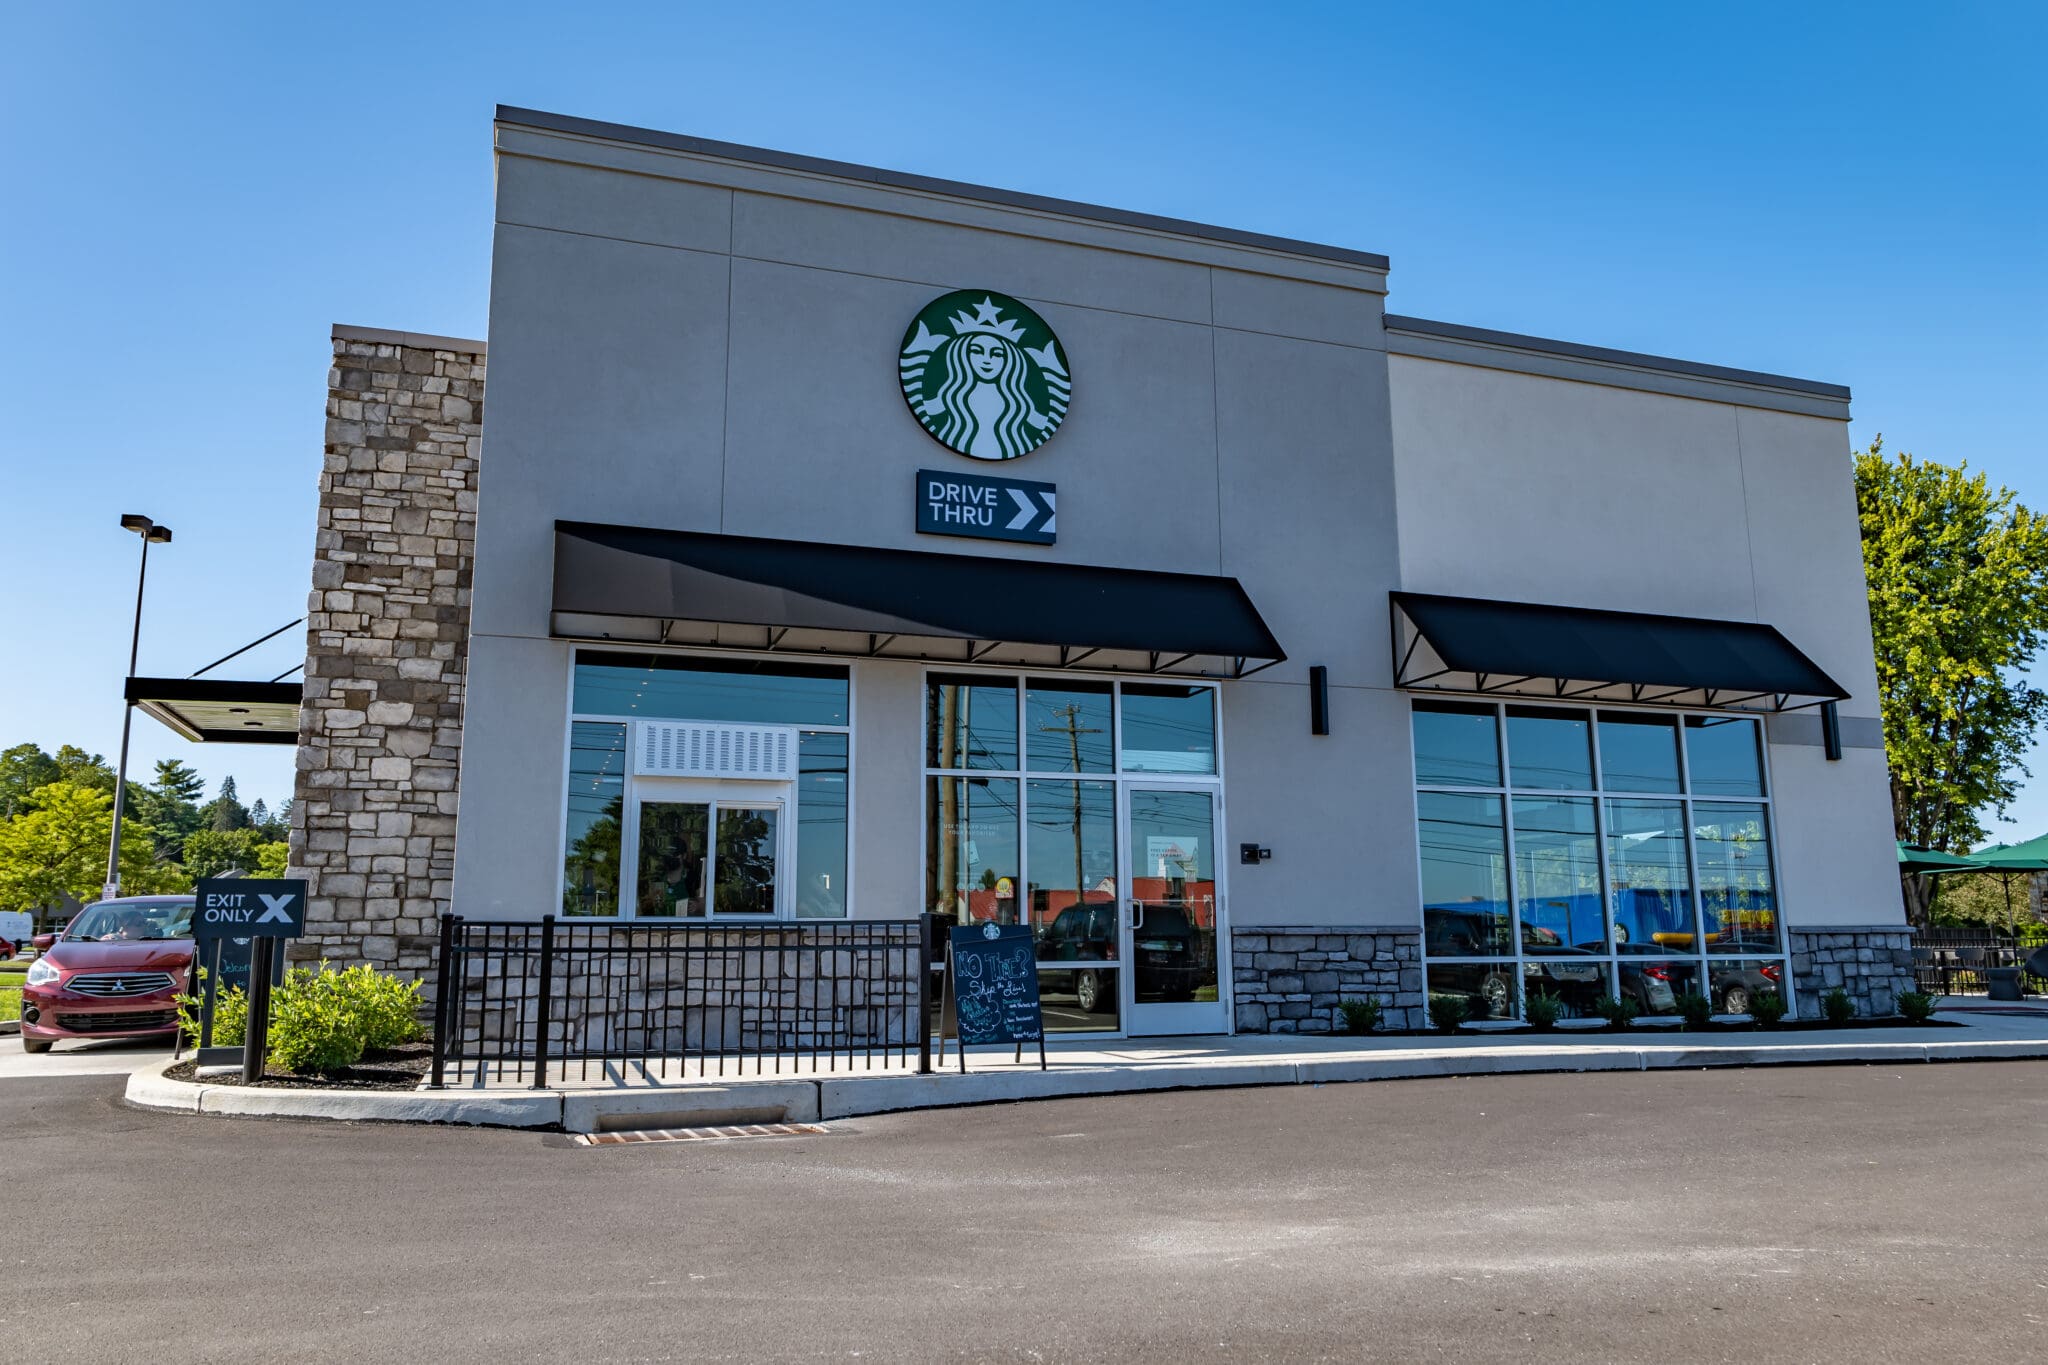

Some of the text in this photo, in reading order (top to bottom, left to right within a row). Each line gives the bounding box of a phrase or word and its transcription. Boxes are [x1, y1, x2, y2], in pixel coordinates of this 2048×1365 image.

[929, 481, 998, 507] DRIVE
[929, 502, 993, 526] THRU
[206, 893, 246, 907] EXIT
[204, 909, 254, 922] ONLY
[956, 951, 982, 978] NO
